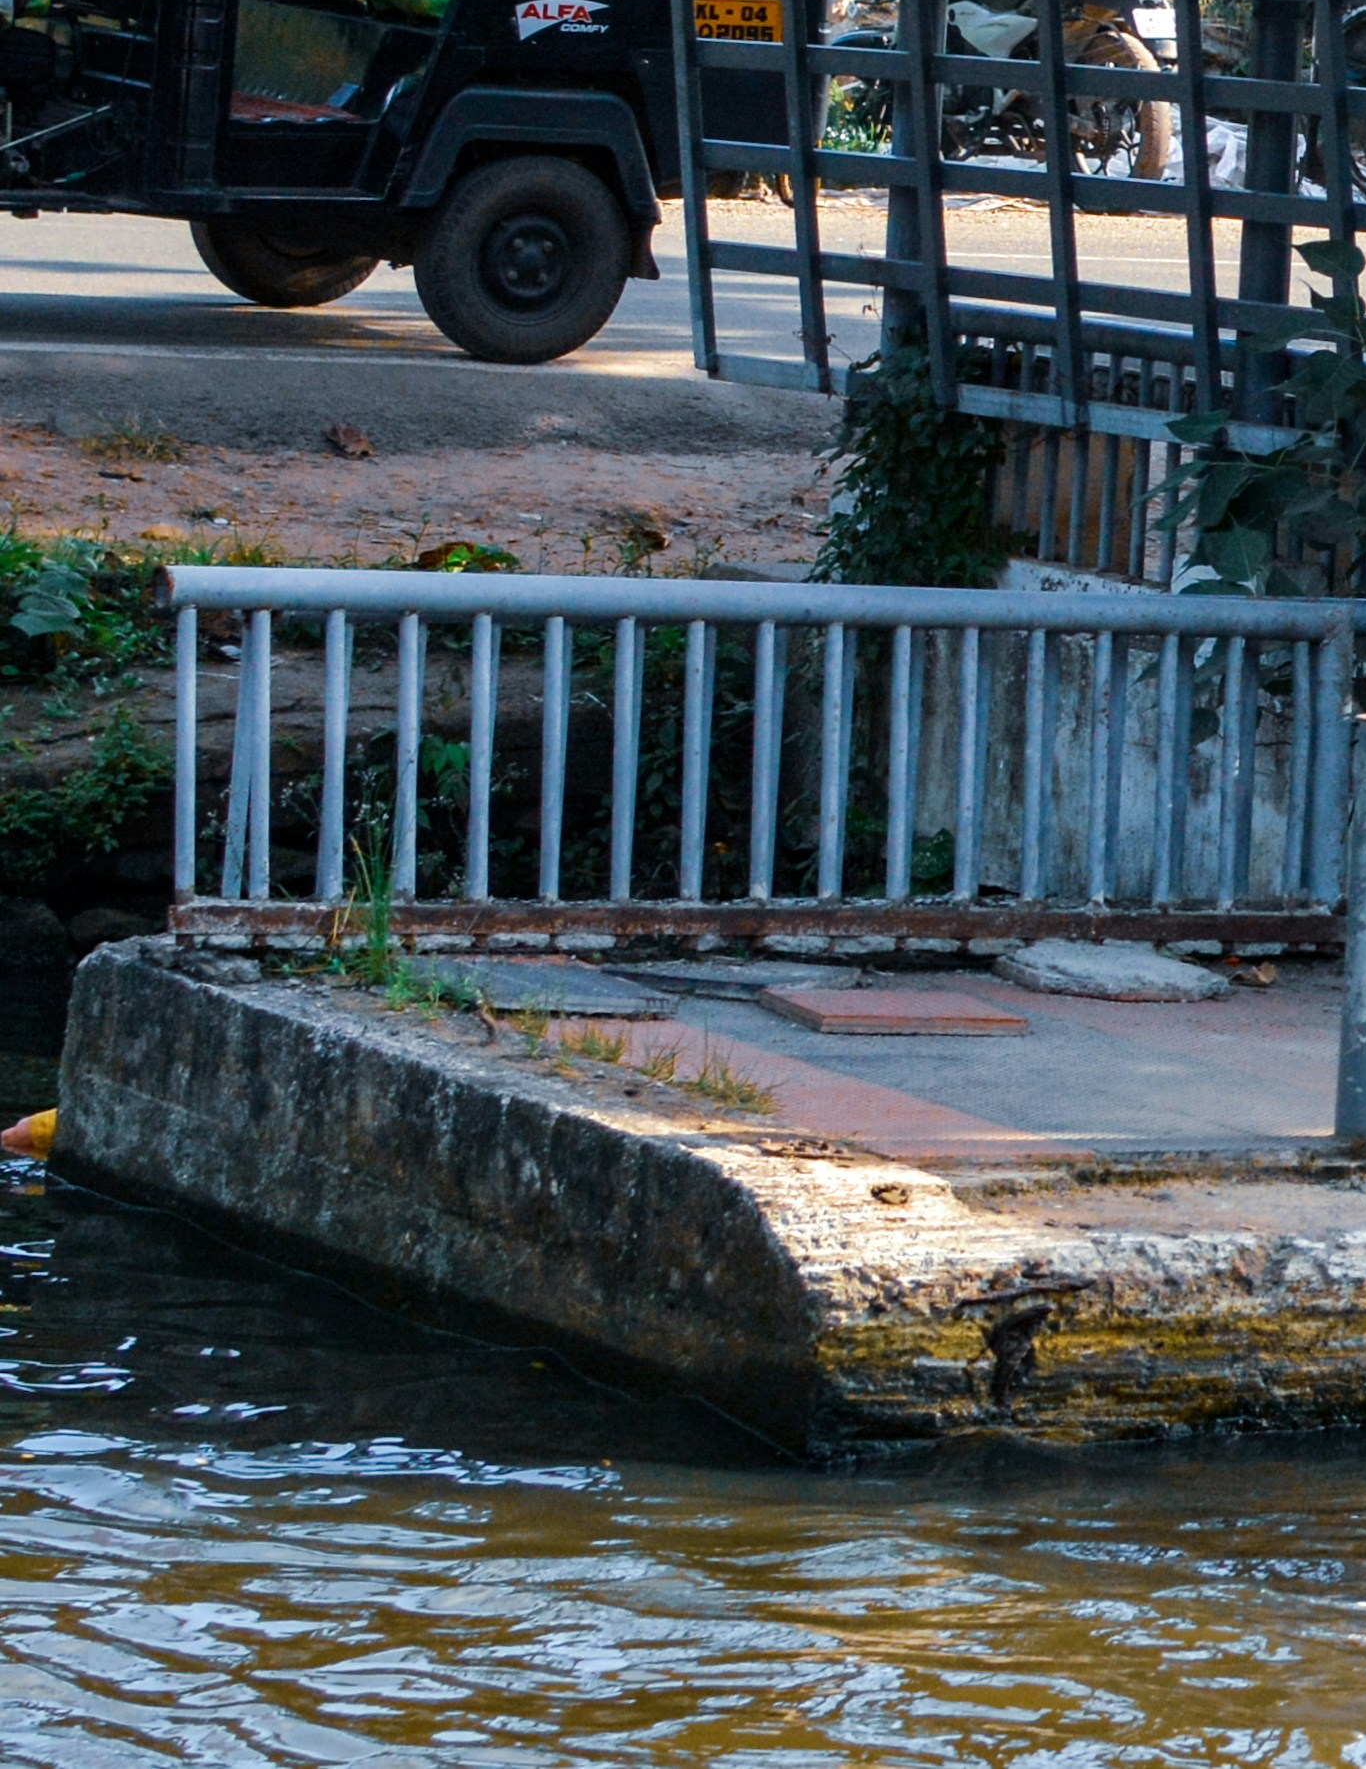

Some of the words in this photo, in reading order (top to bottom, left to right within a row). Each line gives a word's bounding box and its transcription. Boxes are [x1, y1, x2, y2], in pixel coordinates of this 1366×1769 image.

[521, 3, 592, 23] ALFA
[695, 4, 719, 20] KL
[741, 6, 768, 22] 04
[560, 22, 610, 34] COMFY
